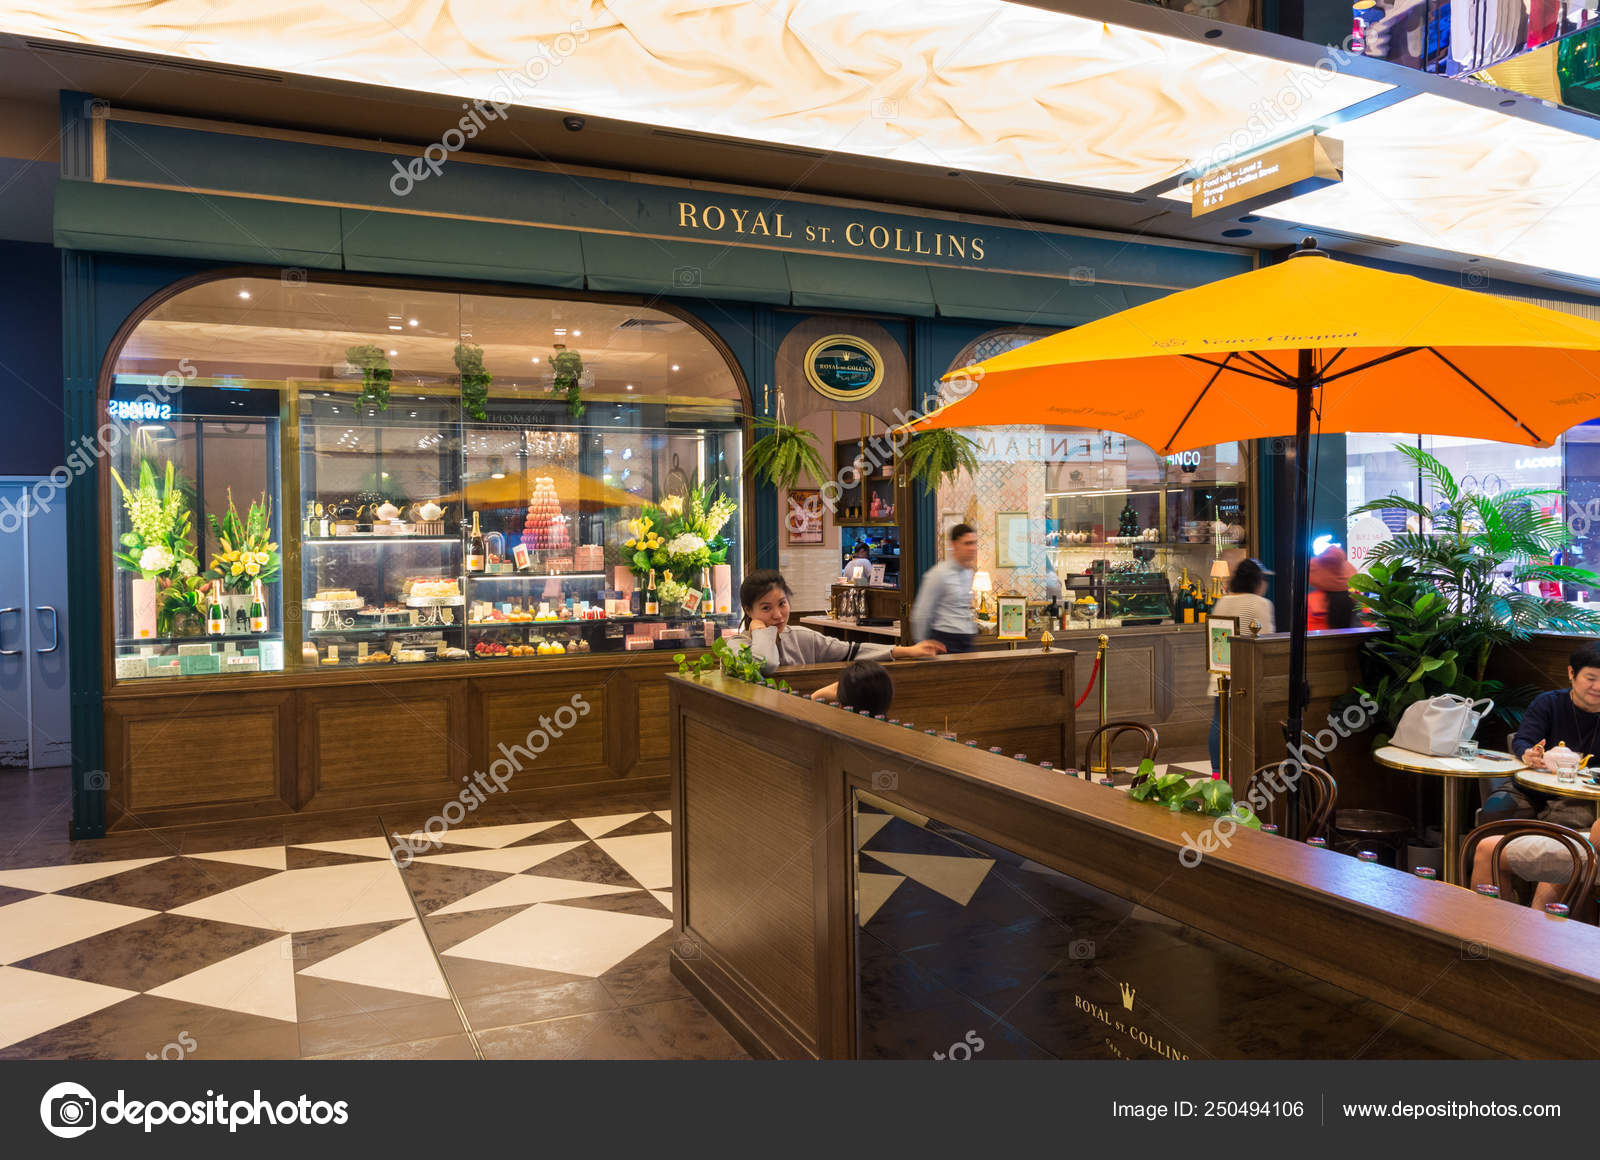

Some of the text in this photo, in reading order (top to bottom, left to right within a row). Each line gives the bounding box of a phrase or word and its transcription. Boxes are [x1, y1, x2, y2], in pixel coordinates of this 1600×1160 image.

[1203, 177, 1219, 188] Food
[1239, 161, 1257, 176] Level
[1203, 184, 1228, 197] Through
[1229, 181, 1236, 189] to
[1258, 164, 1279, 178] Street
[678, 202, 985, 261] ROYAL ST. COLLINS
[1075, 995, 1112, 1026] ROYAL
